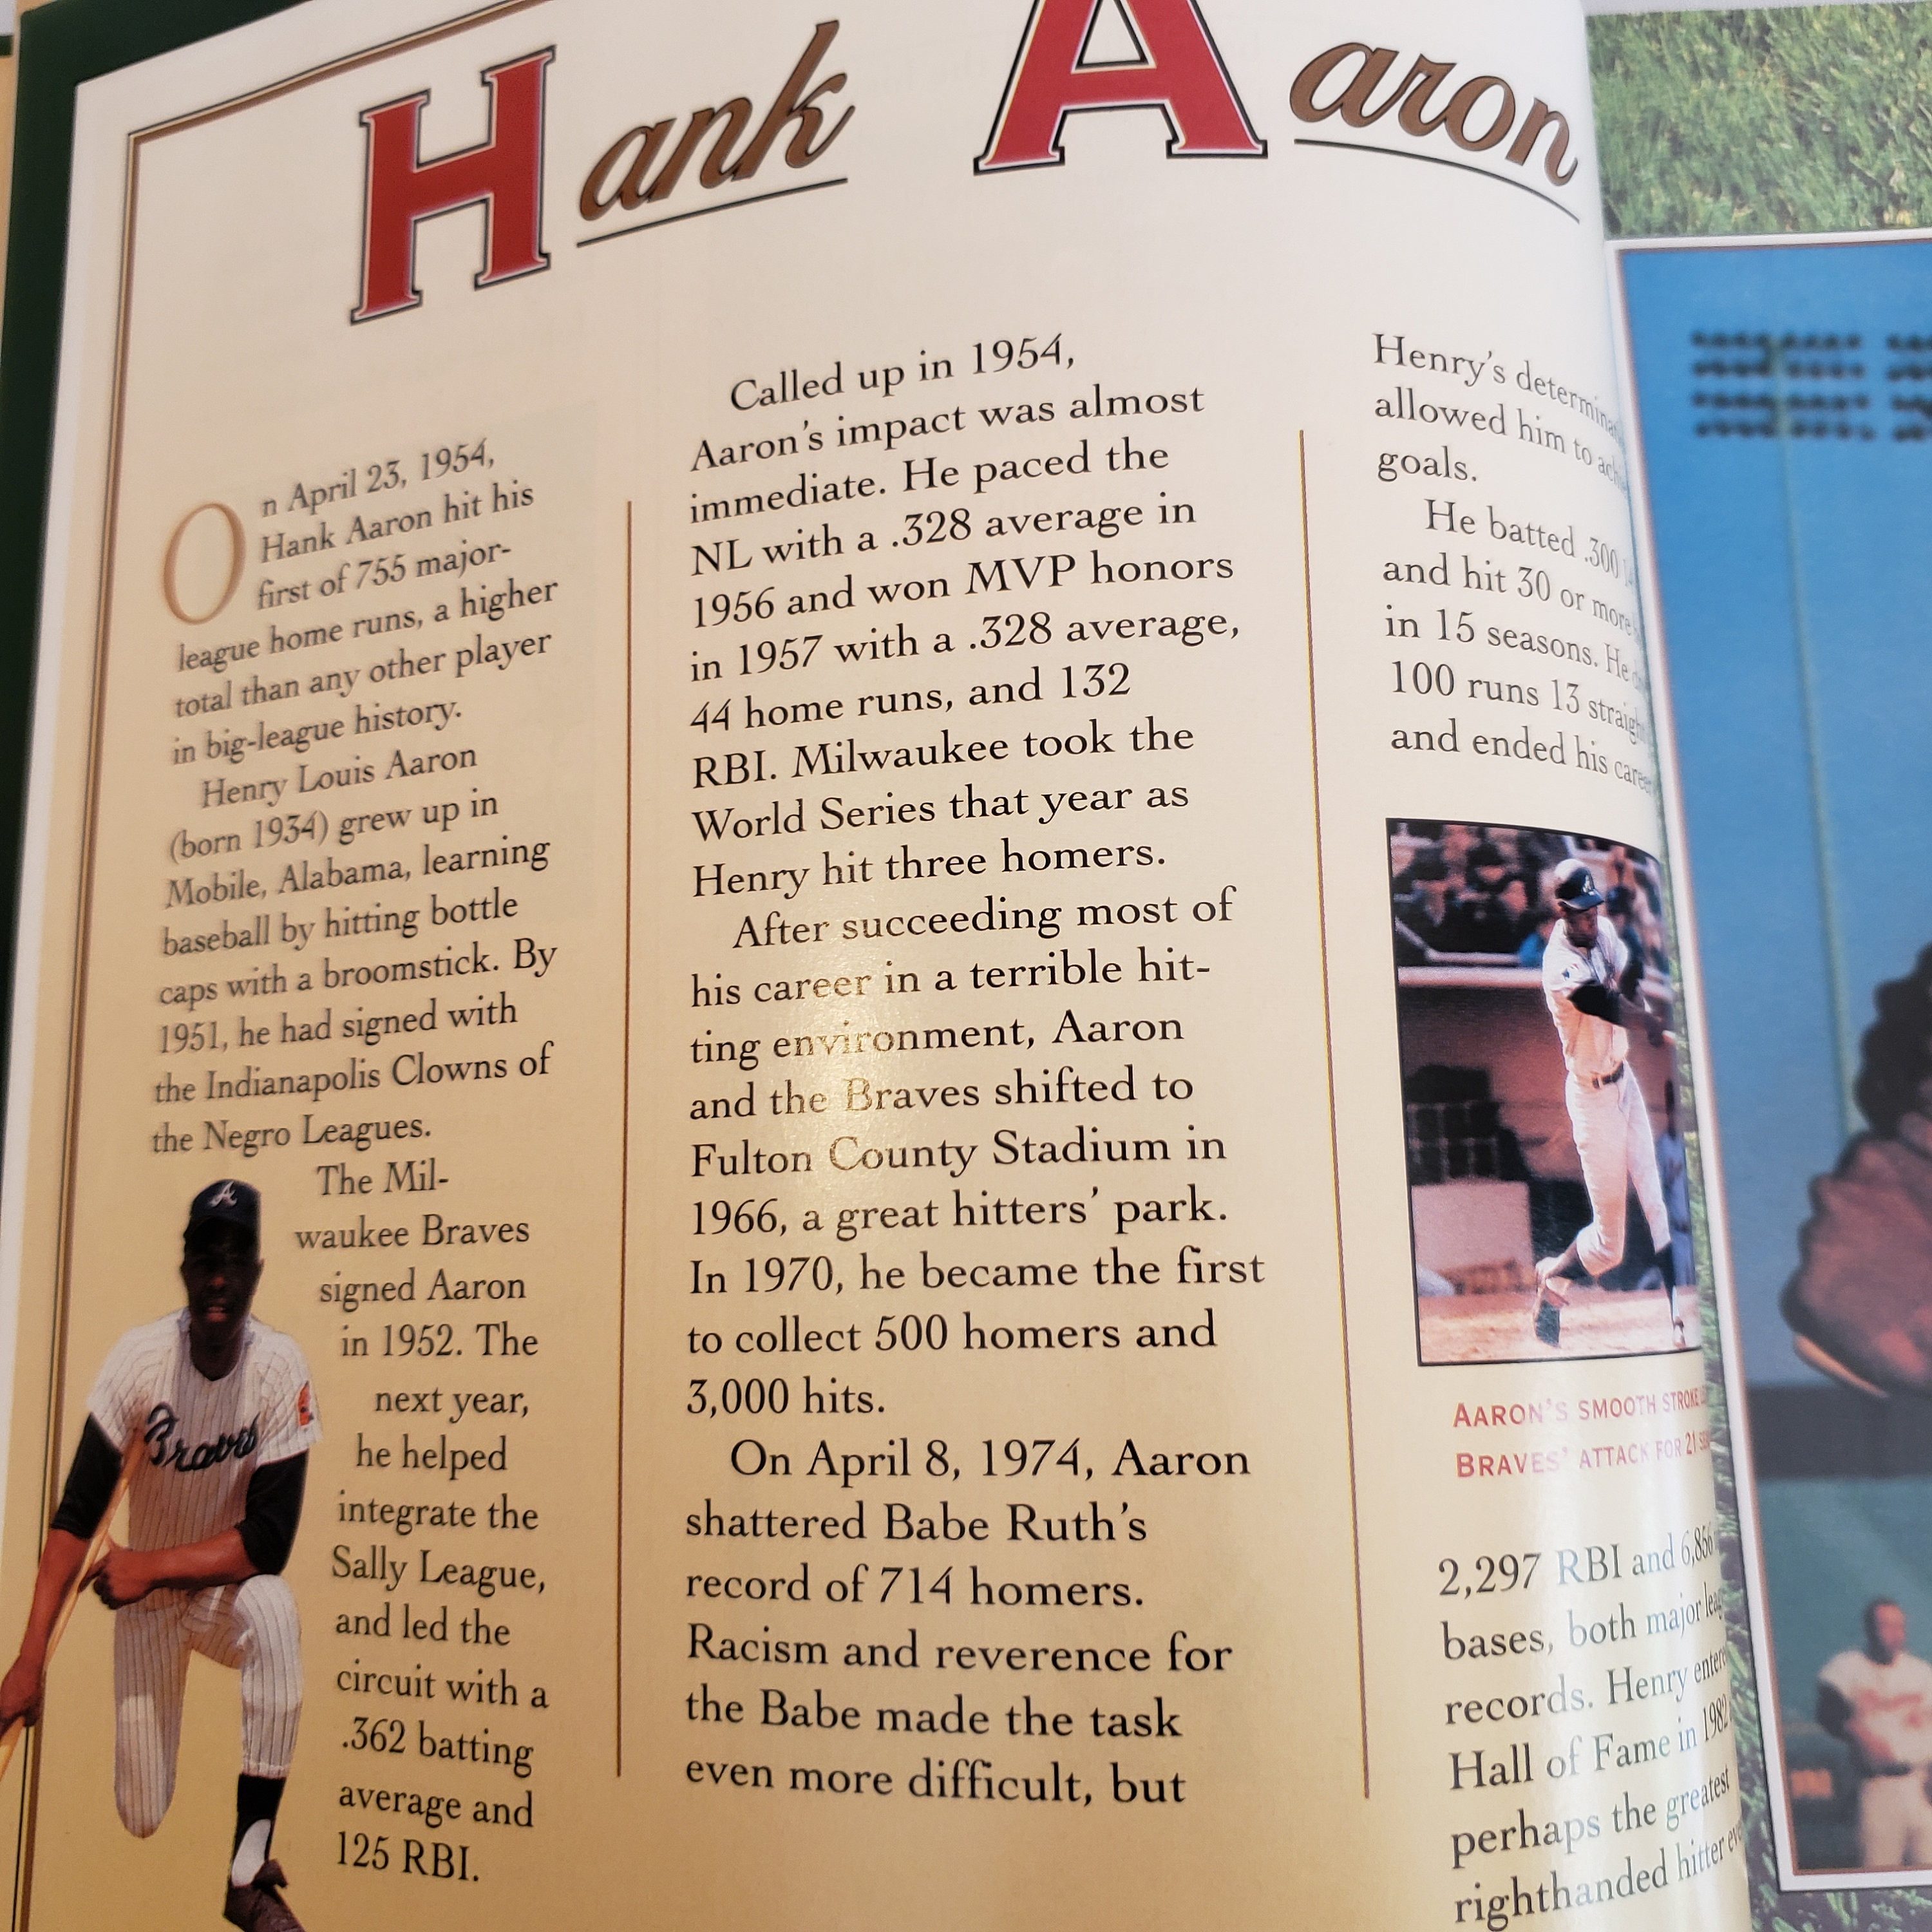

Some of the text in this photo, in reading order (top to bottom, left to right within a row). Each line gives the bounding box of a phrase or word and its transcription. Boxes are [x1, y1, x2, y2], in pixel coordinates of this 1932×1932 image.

[730, 332, 1074, 411] Called up in 1954,
[1372, 333, 1506, 387] Henry's
[1375, 386, 1592, 465] allowed him to
[288, 438, 494, 515] April 23, 1954,
[690, 436, 1169, 524] immediate. He paced the
[1378, 446, 1477, 482] goals.
[262, 479, 534, 563] Hank Aaron hit his
[1425, 498, 1475, 535] He
[1487, 506, 1575, 557] batted
[1584, 536, 1618, 579] .300
[258, 539, 511, 609] first of 755 major-
[695, 549, 1233, 629] 1956 and won MVP honors
[1383, 552, 1450, 586] and
[1461, 555, 1506, 592] hit
[1518, 567, 1550, 601] 30
[1560, 589, 1585, 611] or
[1591, 599, 1632, 636] more
[1385, 604, 1421, 638] in
[1437, 609, 1475, 643] 15
[1488, 627, 1598, 667] seasons.
[1604, 643, 1629, 682] He
[176, 634, 552, 718] total than any other player
[690, 663, 1130, 734] 44 home runs, and 132
[1392, 661, 1454, 696] 100
[1468, 679, 1539, 706] runs
[1551, 679, 1580, 714] 13
[1391, 718, 1608, 775] and ended his
[202, 749, 477, 808] Henry Louis Aaron
[691, 783, 1188, 842] World Series that year as
[166, 835, 551, 909] Mobile, Alabama, learning
[732, 885, 1237, 949] After succeeding most of
[159, 938, 558, 1012] caps with a broomstick. By
[154, 1040, 554, 1103] the Indianapolis Clowns of
[690, 1009, 1184, 1071] ting environment, Aaron
[691, 1124, 1227, 1179] Fulton County Stadium in
[690, 1245, 1265, 1295] In 1970, he became the first
[374, 1388, 528, 1424] next year,
[687, 1376, 884, 1419] 3,000 hits.
[1685, 1430, 1696, 1455] 21
[339, 1490, 538, 1536] integrate the
[686, 1498, 1146, 1542] shattered Babe Ruth's
[1439, 1521, 1714, 1599] 2,297 RBI and 6,856
[336, 1602, 510, 1646] and led the
[688, 1623, 1233, 1672] Racism and reverence for
[1441, 1591, 1702, 1660] bases, both major
[1445, 1666, 1684, 1725] records. Henry
[343, 1716, 534, 1779] .362 batting
[1449, 1742, 1534, 1790] Hall
[1547, 1736, 1582, 1779] of
[1594, 1733, 1669, 1771] Fame
[1678, 1716, 1698, 1752] in
[1703, 1692, 1728, 1743] 1982
[686, 1757, 1186, 1807] even more difficult, but
[1451, 1763, 1730, 1870] perhaps the greatest
[337, 1831, 478, 1882] 125 RBI.
[1455, 1837, 1725, 1932] righthanded hitter
